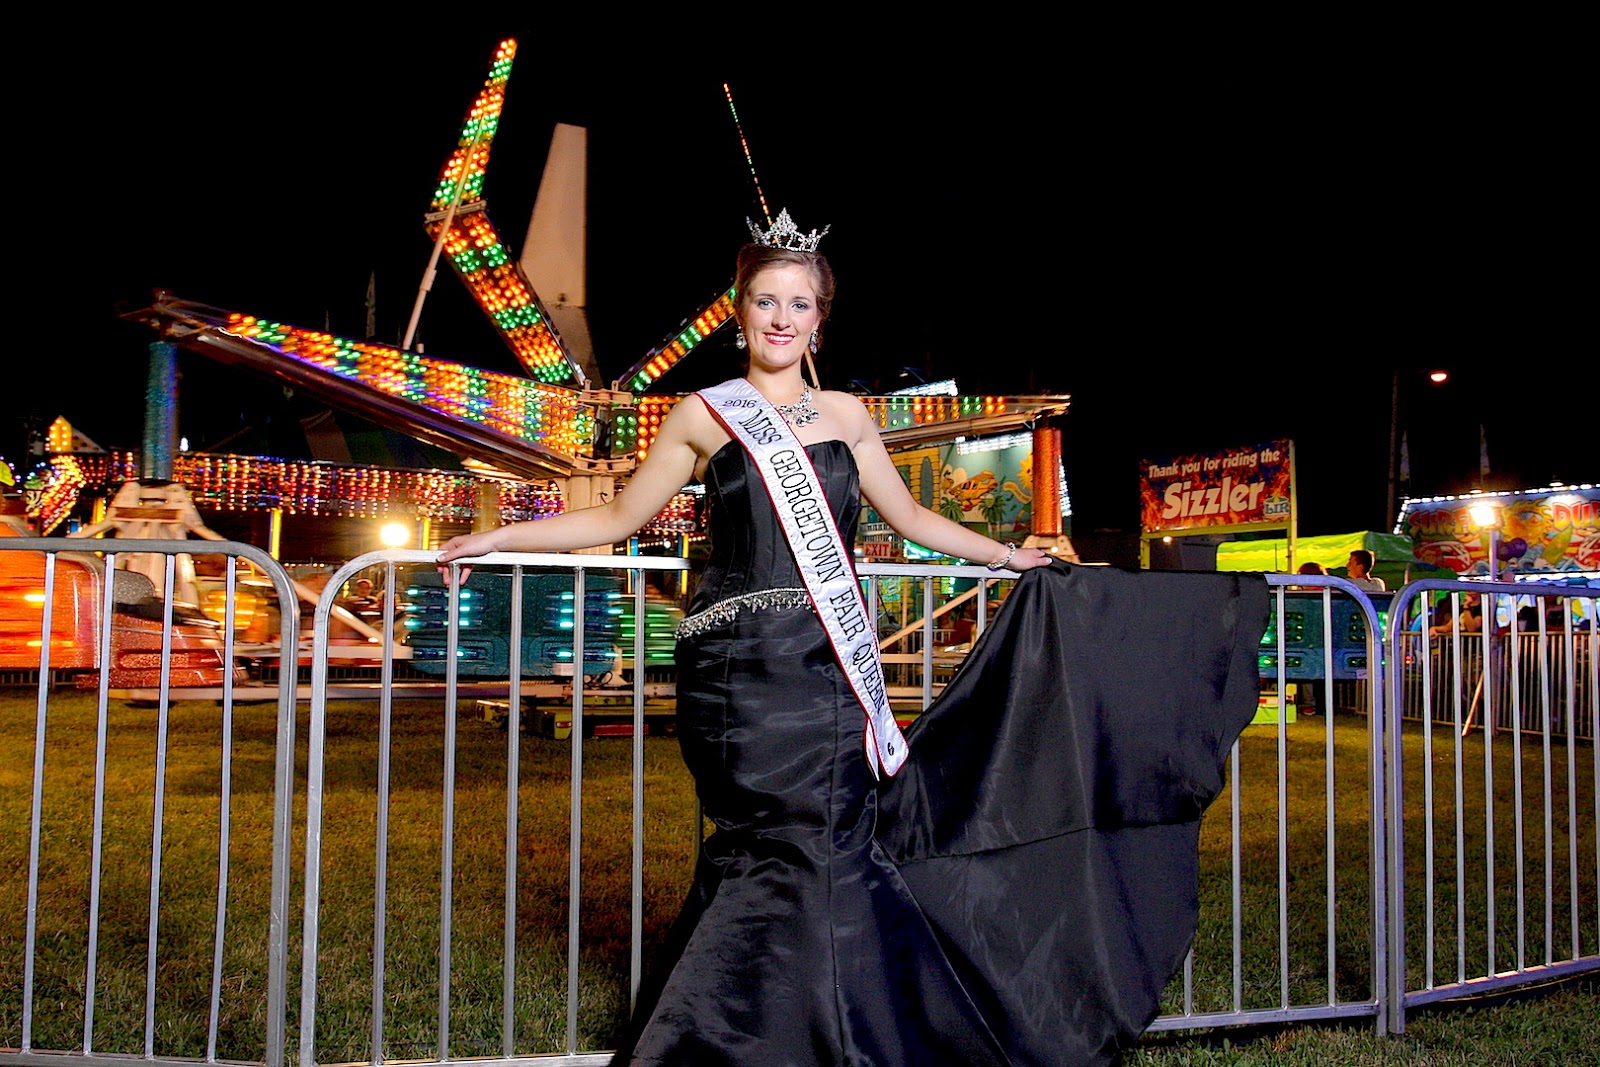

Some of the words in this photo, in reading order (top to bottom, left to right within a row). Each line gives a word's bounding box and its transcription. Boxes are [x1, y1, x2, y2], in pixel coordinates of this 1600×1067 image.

[722, 399, 757, 408] 2016
[1149, 463, 1179, 479] Thank
[1181, 461, 1200, 476] you
[1203, 457, 1219, 471] for
[1222, 452, 1258, 468] riding
[1260, 448, 1281, 462] the
[1162, 476, 1266, 520] Sizzler
[738, 408, 782, 446] MISS
[769, 449, 846, 584] GEORGETOWN
[829, 586, 866, 642] FAIR
[852, 643, 886, 714] QUEEN
[865, 543, 890, 557] EXIT
